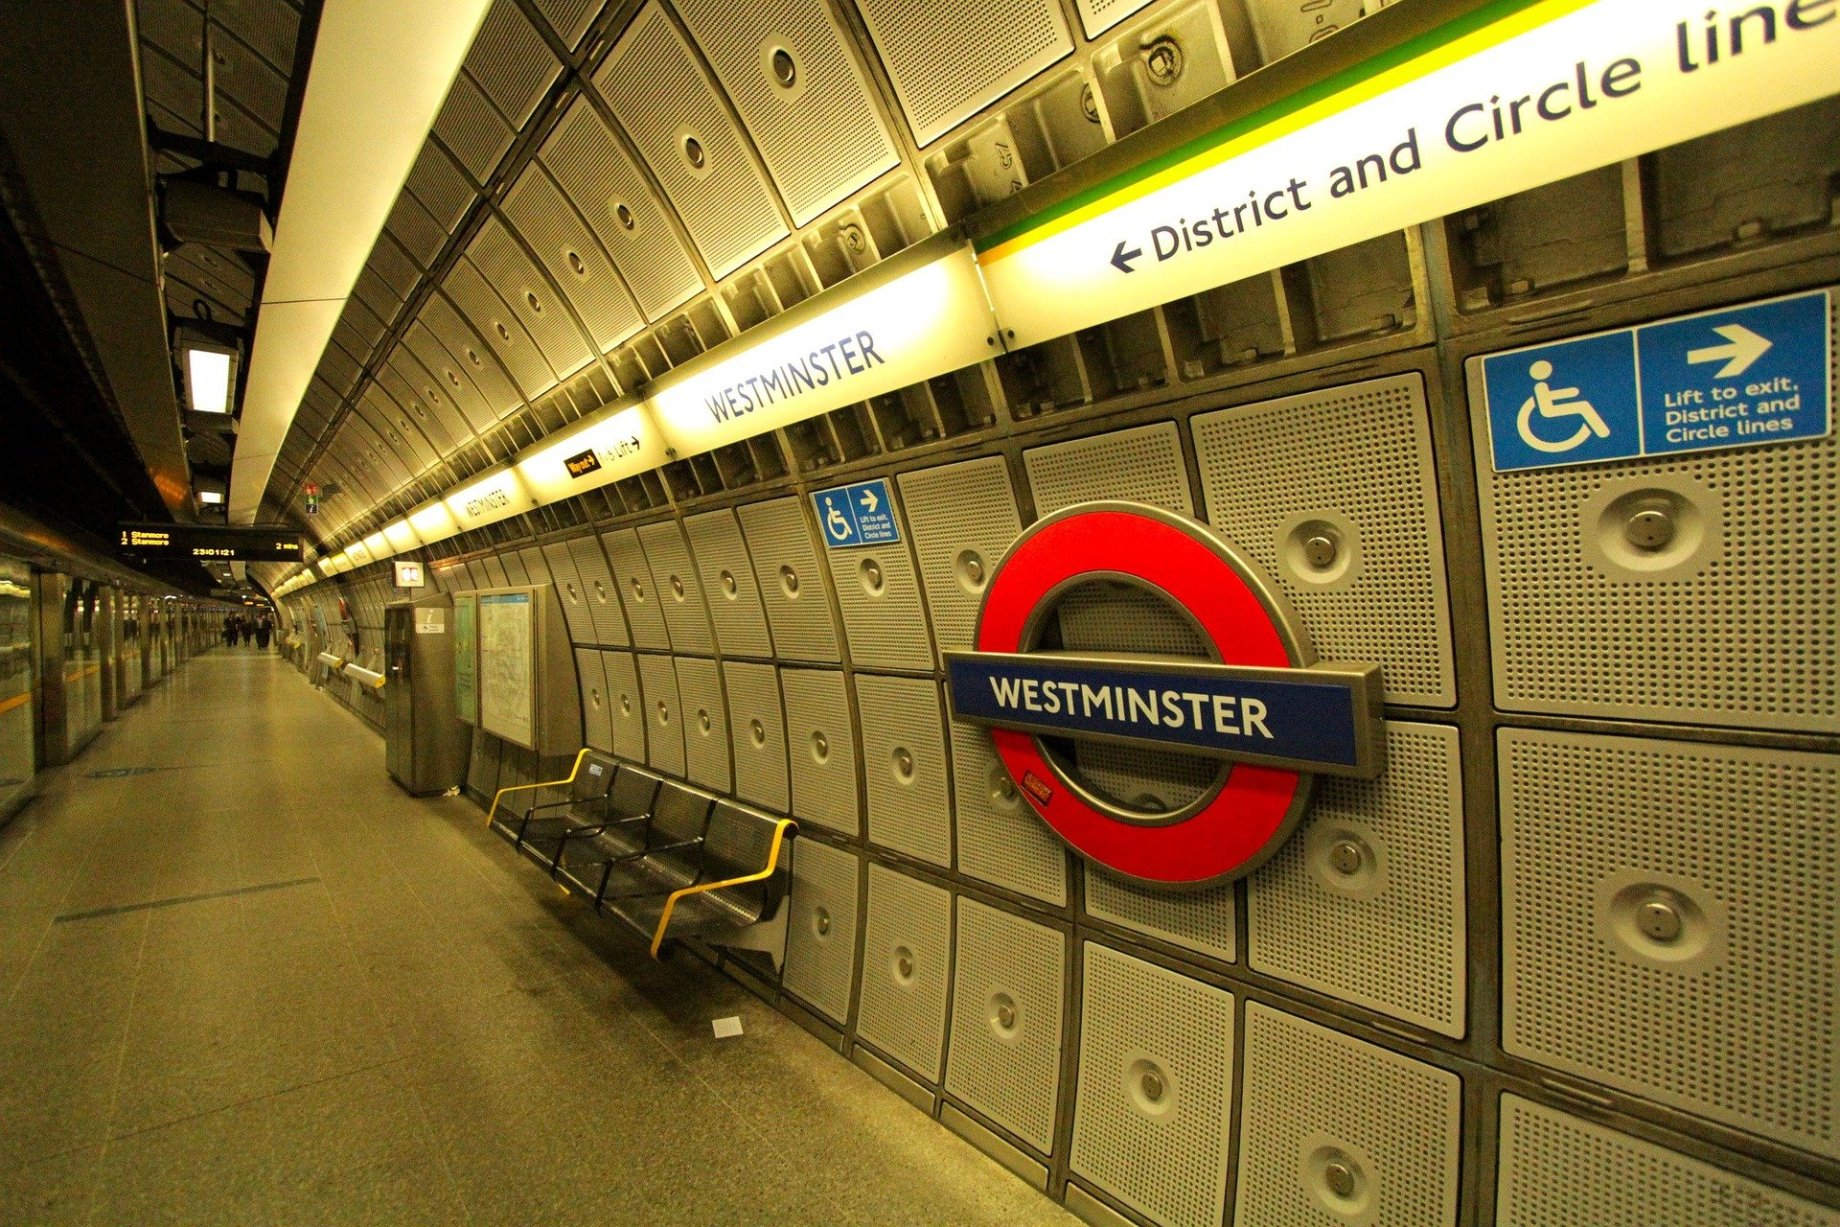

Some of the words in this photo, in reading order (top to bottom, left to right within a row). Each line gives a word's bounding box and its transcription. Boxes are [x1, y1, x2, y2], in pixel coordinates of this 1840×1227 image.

[1150, 178, 1312, 262] District
[1329, 127, 1422, 199] and
[1444, 57, 1642, 153] Circle
[703, 330, 886, 424] WESTMINSTER
[1664, 389, 1704, 407] Lift
[1711, 386, 1738, 401] to
[1665, 402, 1749, 426] District
[1756, 393, 1801, 414] and
[1665, 424, 1730, 443] Circle
[1737, 417, 1793, 436] lines
[131, 531, 170, 539] Stanmore
[131, 538, 170, 546] Stanmore
[275, 542, 282, 550] 2
[988, 676, 1275, 739] WESTMINSTER
